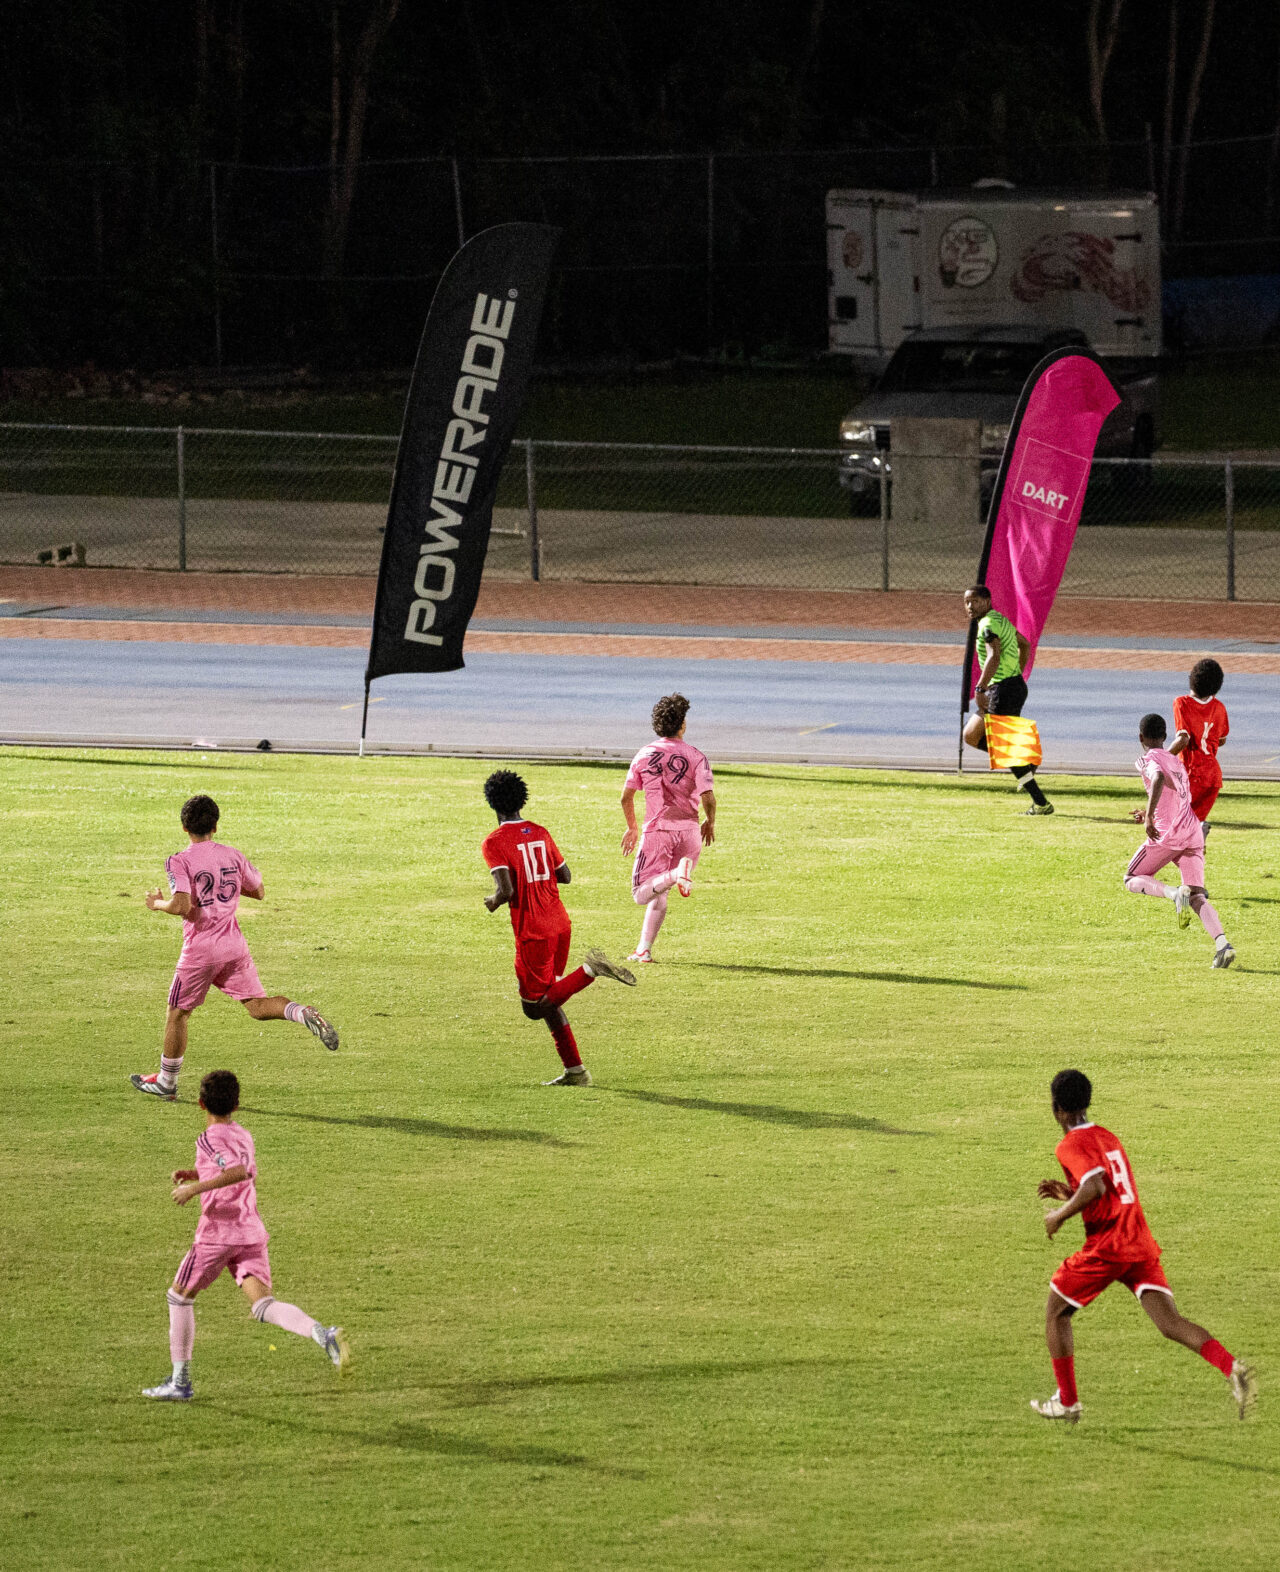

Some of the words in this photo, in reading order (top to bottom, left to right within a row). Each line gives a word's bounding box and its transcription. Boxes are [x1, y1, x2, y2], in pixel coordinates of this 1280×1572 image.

[1022, 481, 1069, 510] DART
[643, 751, 689, 785] 39
[516, 840, 550, 884] 10
[193, 865, 239, 908] 25
